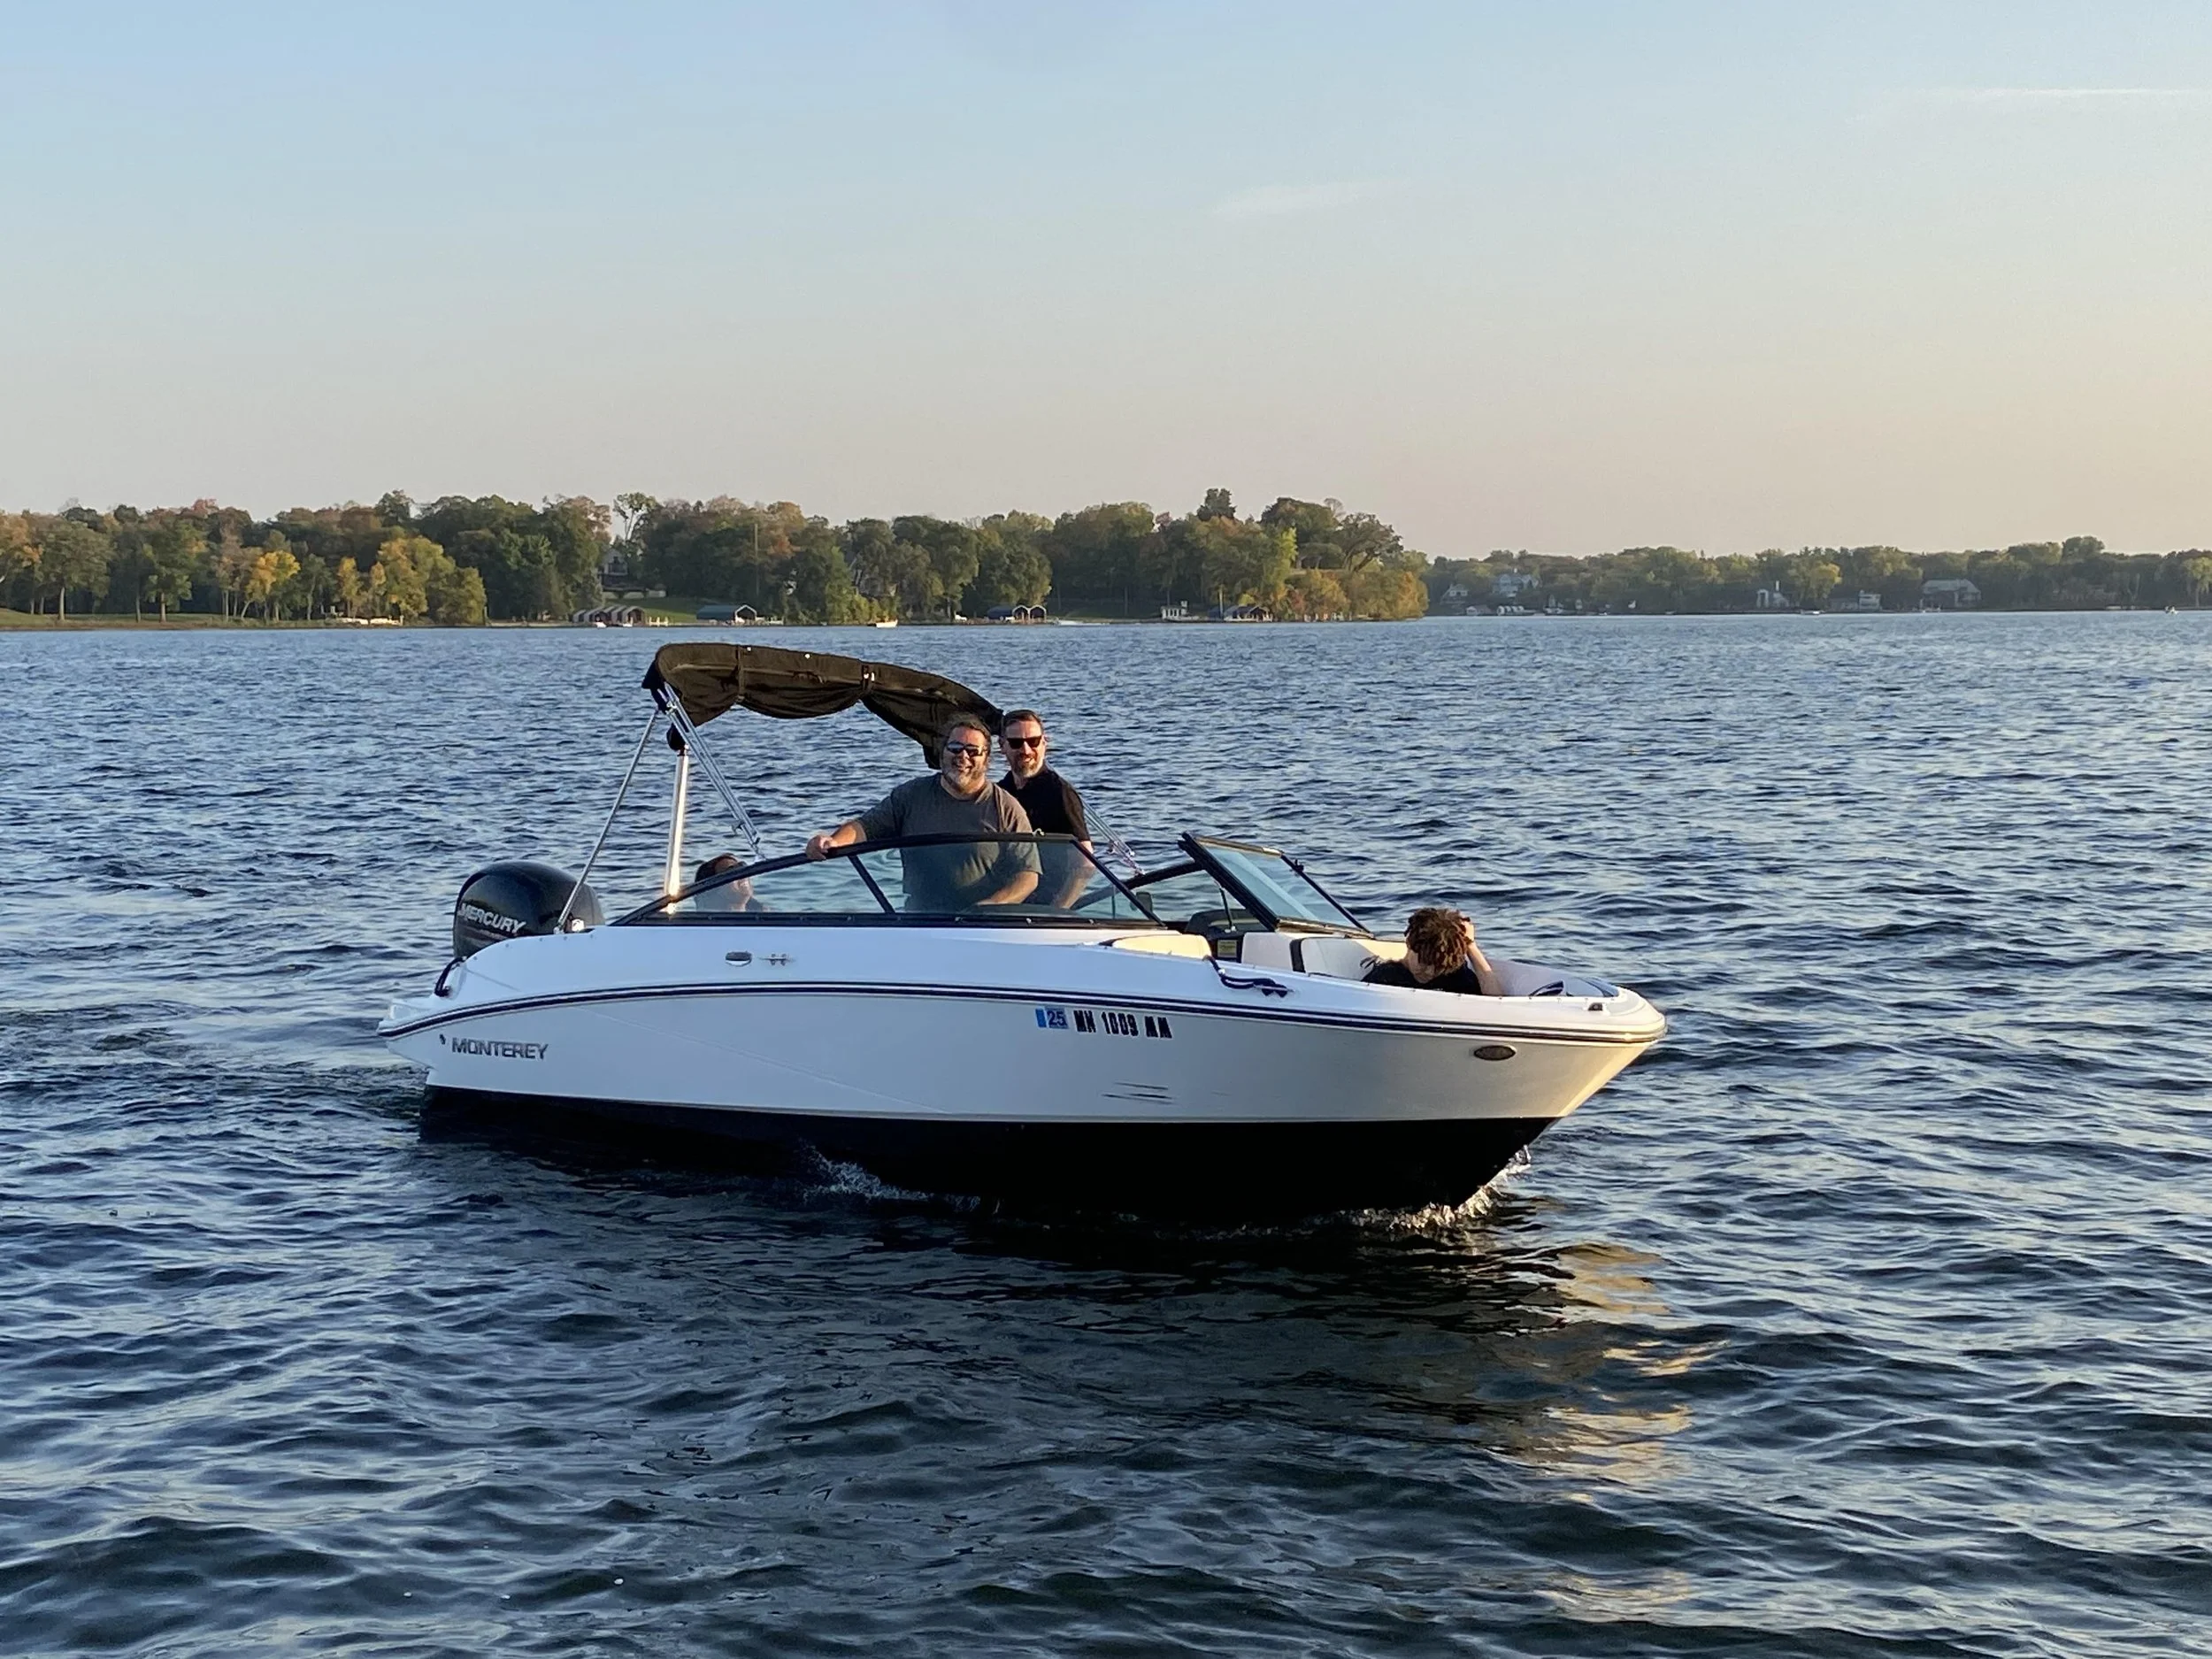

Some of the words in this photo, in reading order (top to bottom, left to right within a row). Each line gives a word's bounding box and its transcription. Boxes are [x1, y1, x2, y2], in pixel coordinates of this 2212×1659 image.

[458, 902, 527, 933] MERCURY
[1048, 1010, 1067, 1026] 25
[1101, 1011, 1139, 1036] 1009
[451, 1036, 549, 1060] MONTEREY
